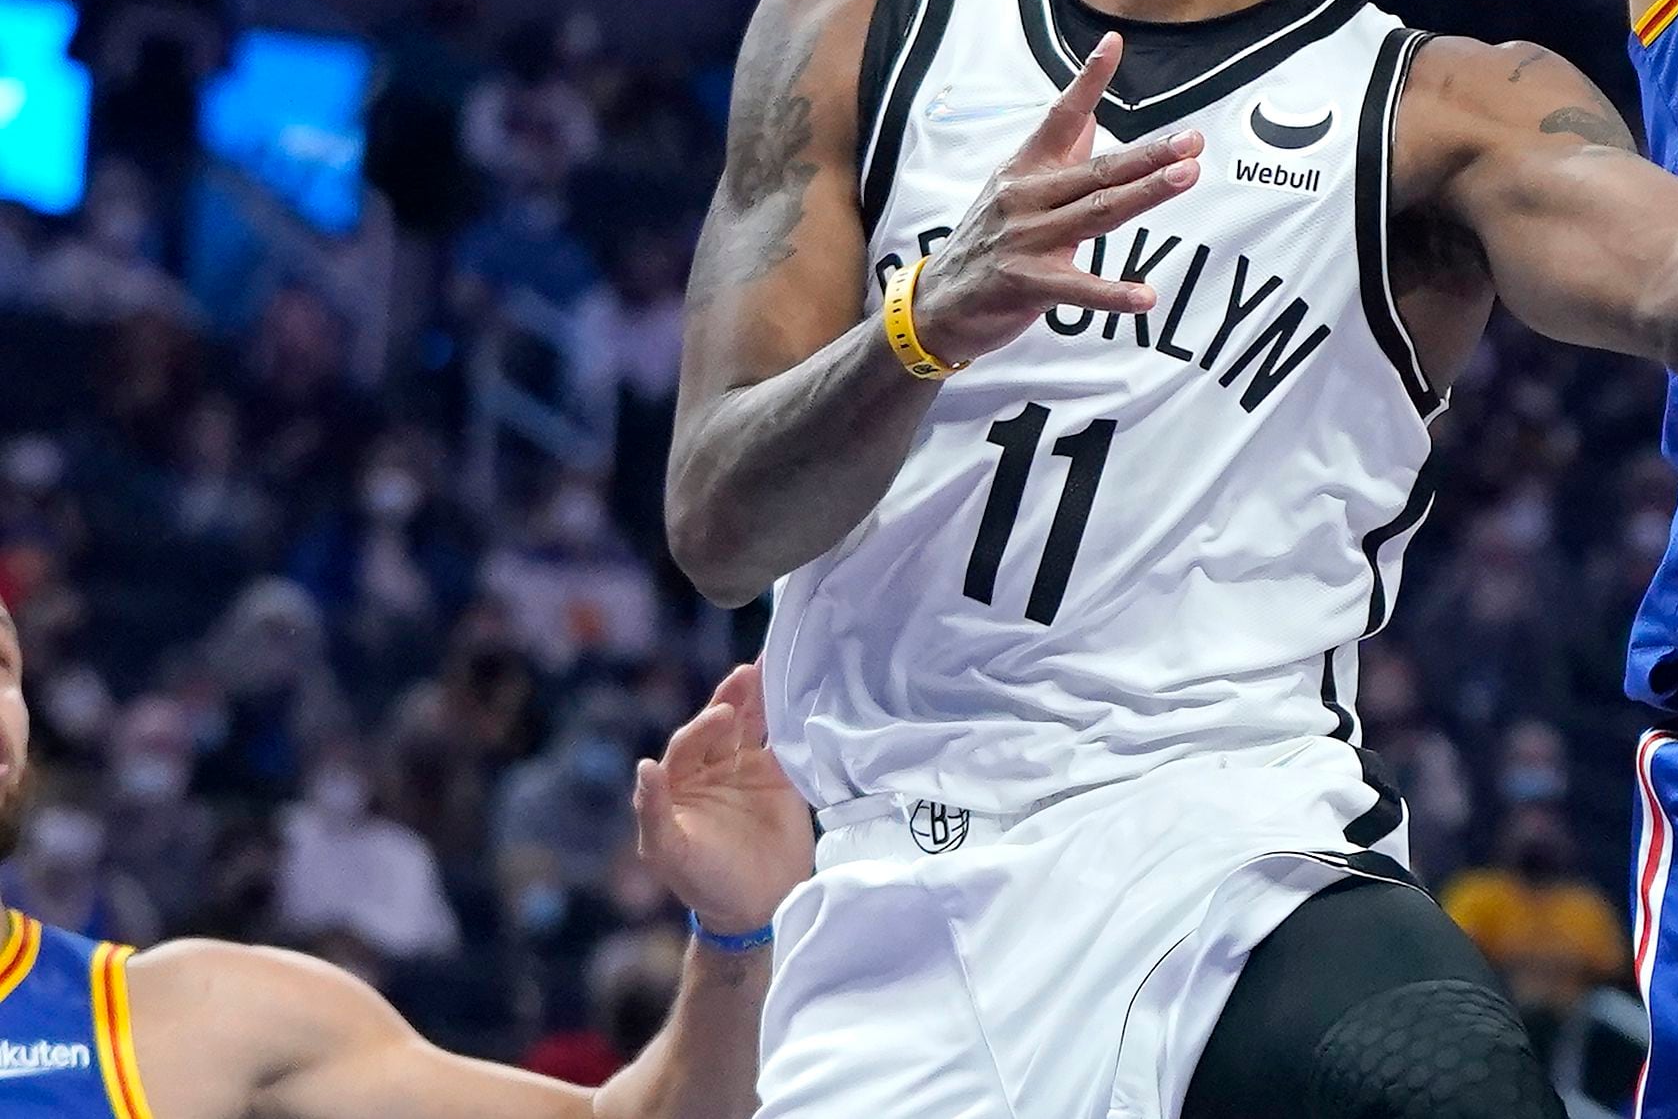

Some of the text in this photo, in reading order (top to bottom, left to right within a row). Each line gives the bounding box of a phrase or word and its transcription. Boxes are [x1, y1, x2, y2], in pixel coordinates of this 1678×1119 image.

[1236, 159, 1321, 192] Webull
[963, 401, 1119, 627] 11
[0, 1038, 91, 1068] kuten
